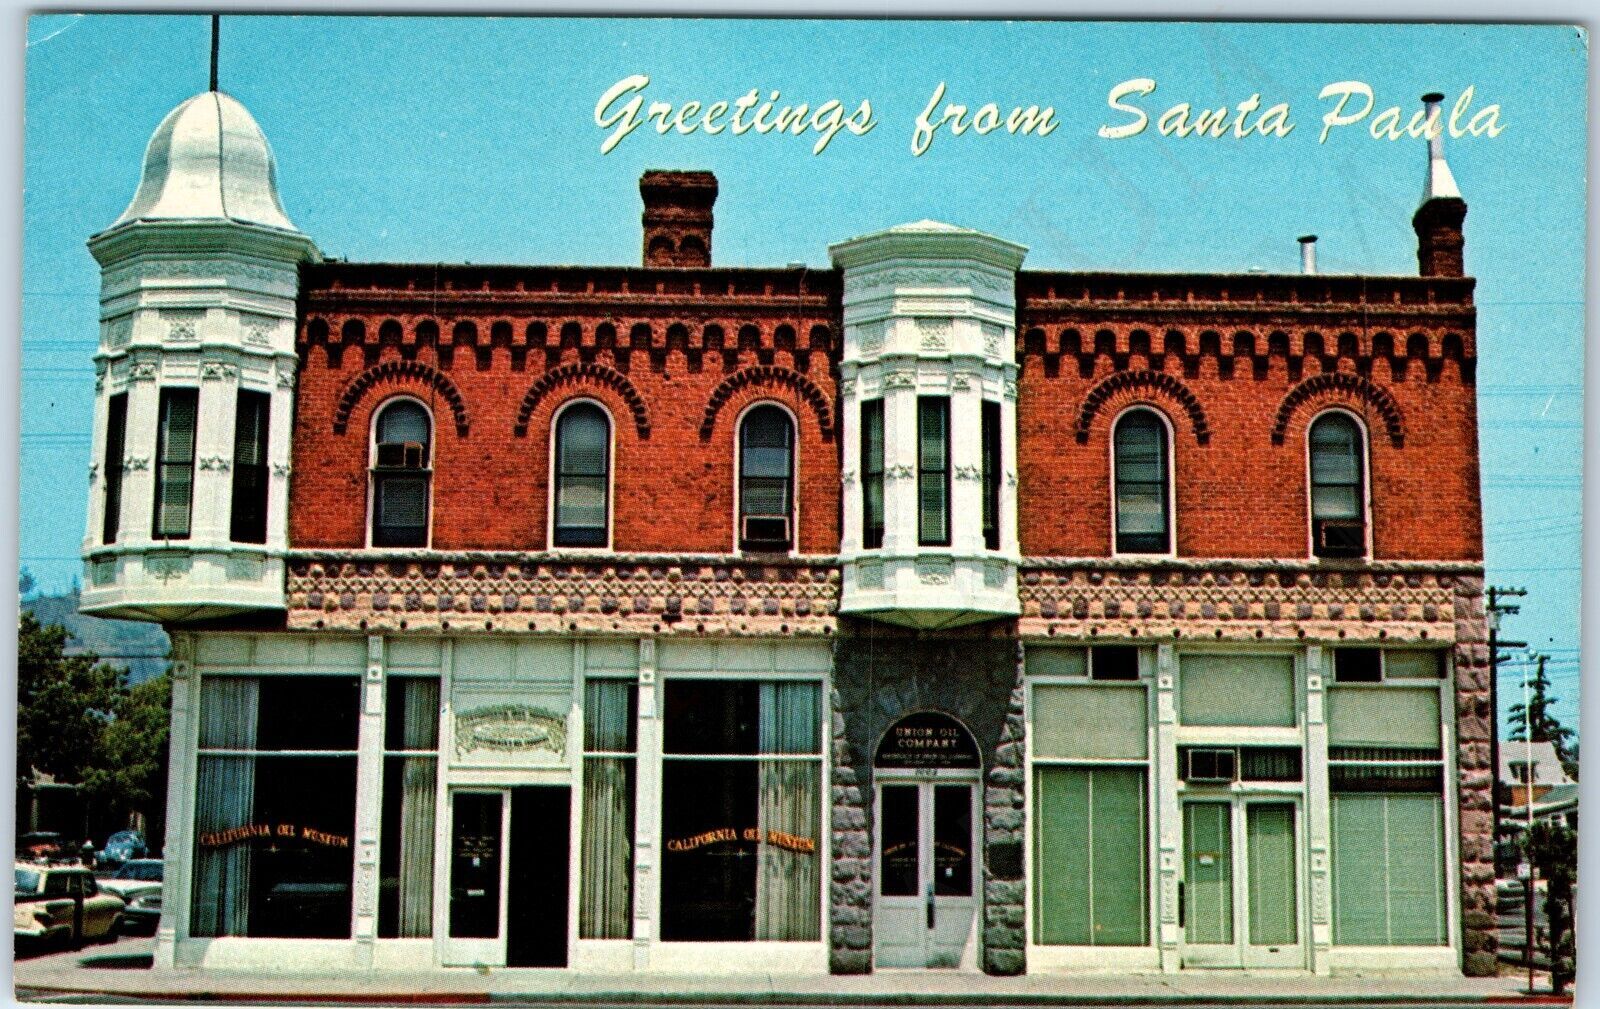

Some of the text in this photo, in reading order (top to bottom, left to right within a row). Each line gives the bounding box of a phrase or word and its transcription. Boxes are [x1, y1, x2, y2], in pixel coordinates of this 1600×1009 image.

[896, 727, 960, 737] UNION OIL
[897, 739, 958, 748] COMPANY
[200, 823, 349, 848] CALIFORNIA OIL MUSEUM
[667, 828, 815, 852] CALIFORNIA OIL MUSEUM
